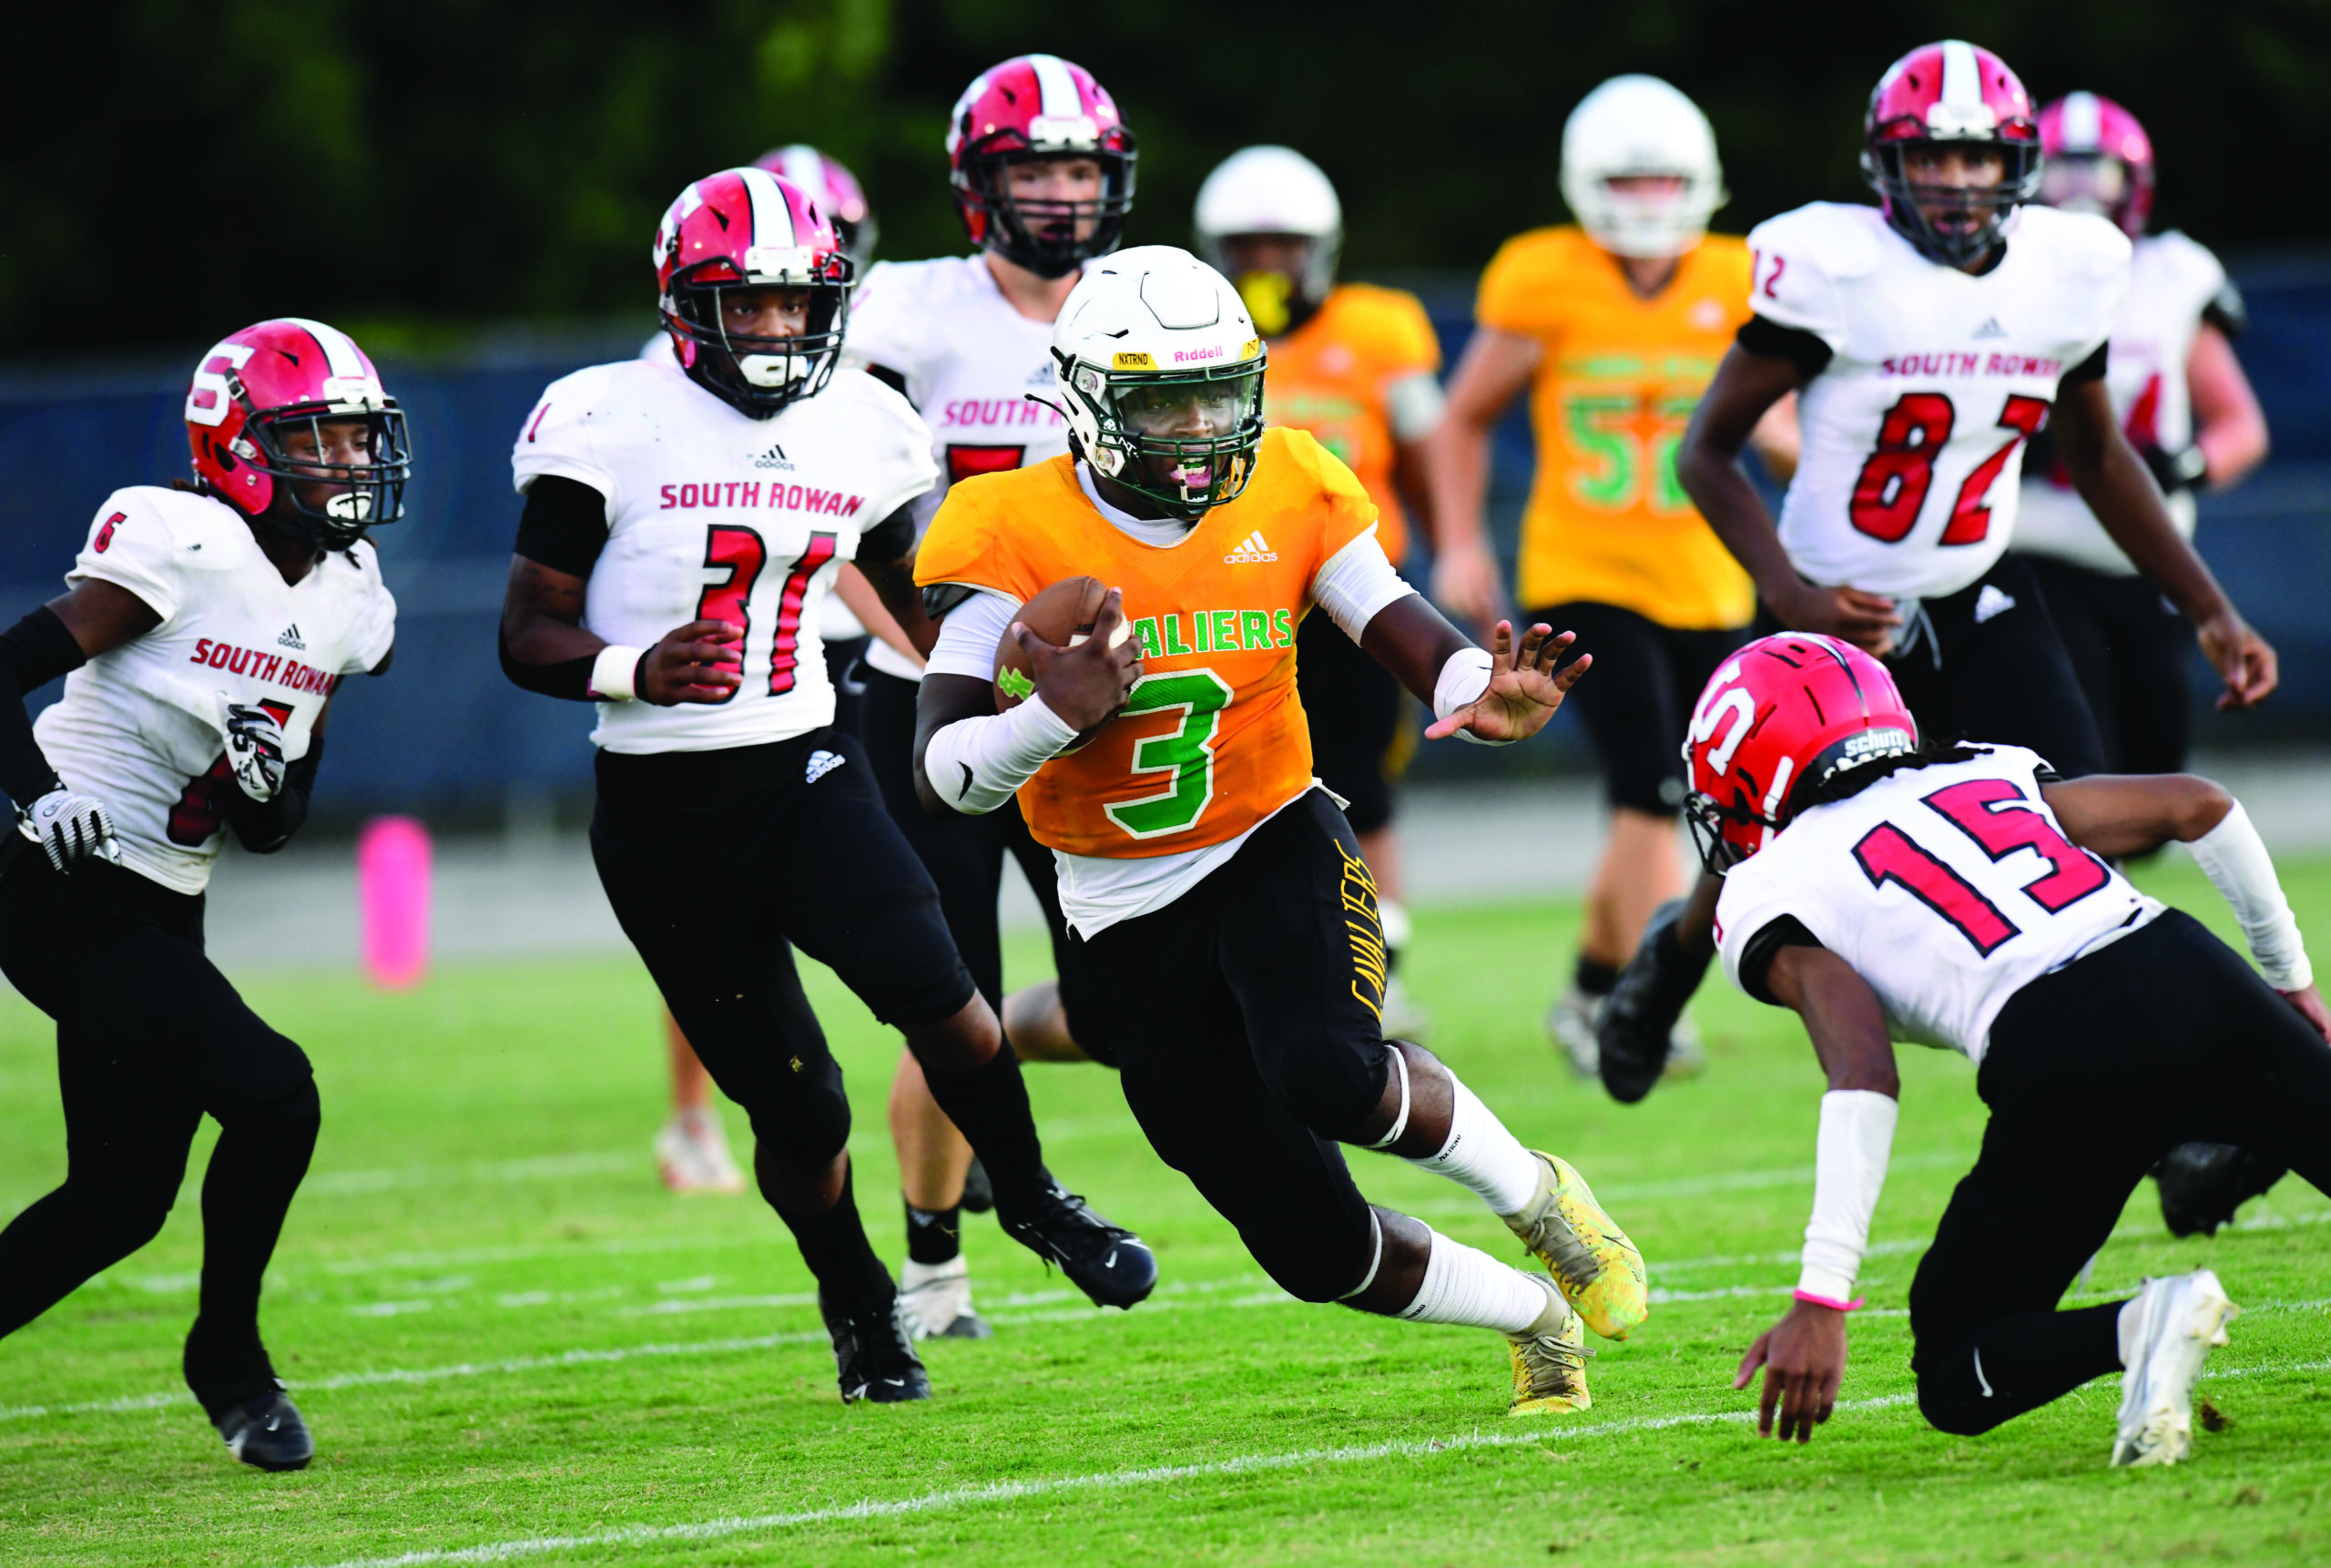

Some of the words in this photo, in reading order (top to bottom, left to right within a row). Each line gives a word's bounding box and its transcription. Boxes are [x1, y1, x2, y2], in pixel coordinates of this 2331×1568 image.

[1118, 353, 1148, 366] NXTRND
[1174, 346, 1224, 362] Riddell
[1881, 352, 1978, 376] SOUTH
[185, 343, 254, 426] S
[940, 399, 1040, 429] SOUTH
[1848, 393, 2051, 546] 82
[660, 482, 769, 510] SOUTH
[769, 483, 866, 517] ROWAN
[94, 512, 127, 554] 6
[1224, 550, 1278, 565] adidas
[690, 524, 839, 705] 31
[1125, 608, 1293, 660] ALIERS
[189, 637, 282, 682] SOUTH
[279, 659, 337, 697] ROWAN
[1688, 661, 1756, 776] S
[1104, 667, 1235, 840] 3
[1851, 779, 2112, 960] 15
[1334, 839, 1386, 1023] CAVALIERS
